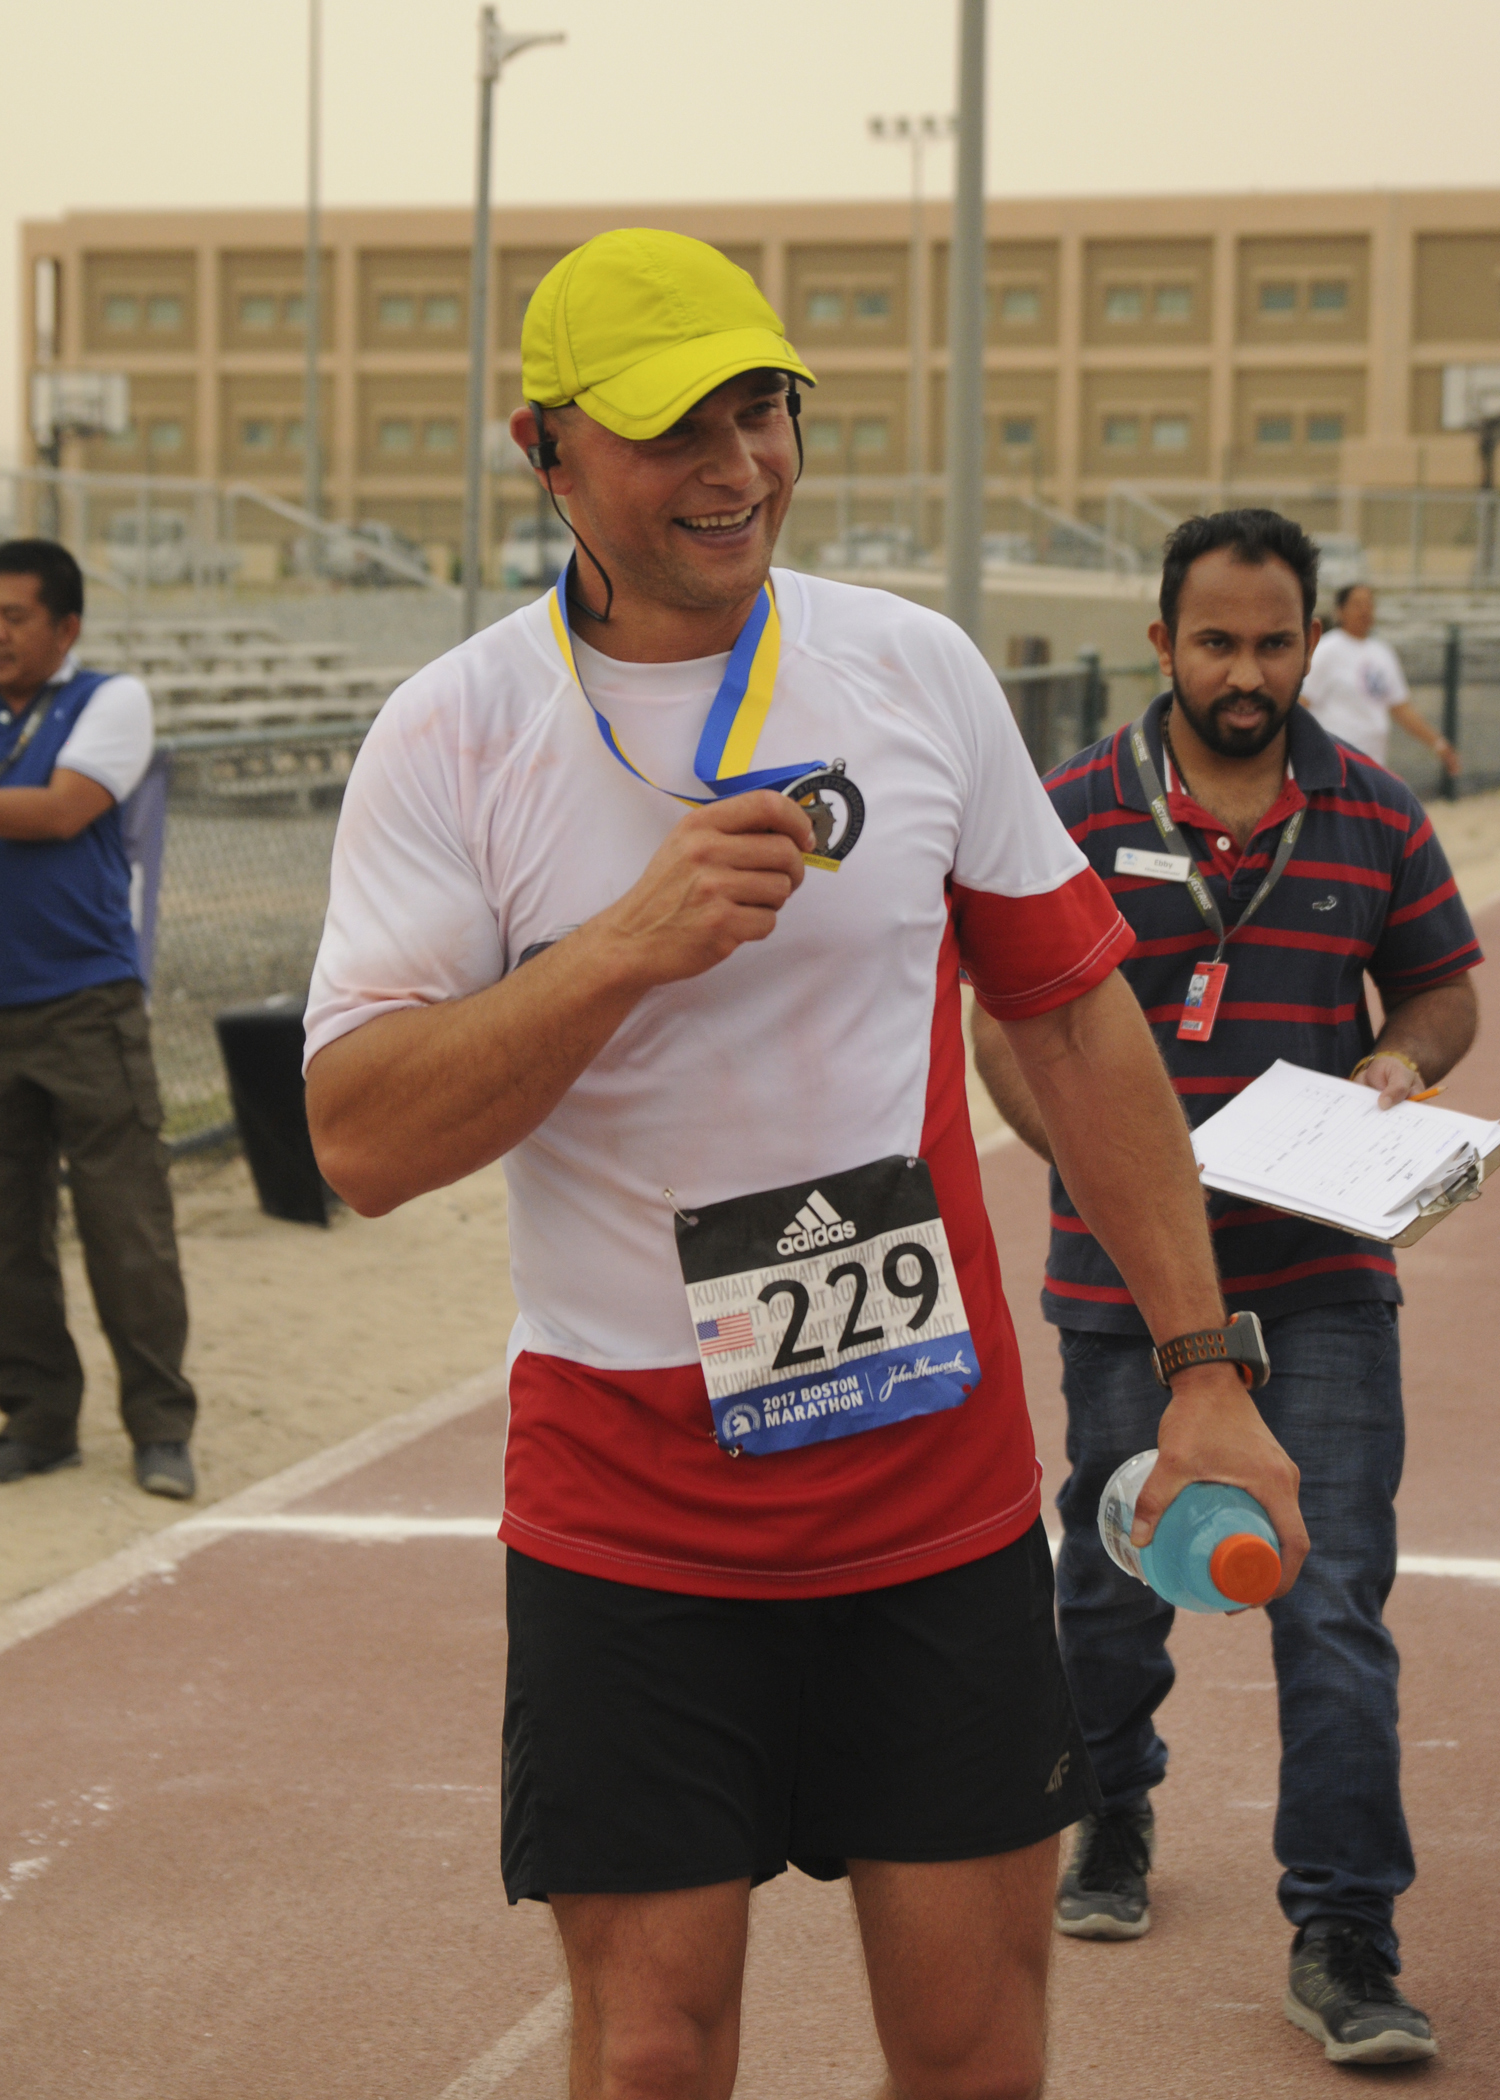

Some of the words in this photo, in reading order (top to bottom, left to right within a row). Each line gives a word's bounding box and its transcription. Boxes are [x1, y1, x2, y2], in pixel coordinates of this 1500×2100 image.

[1151, 799, 1175, 833] VECTRUS
[1154, 859, 1173, 869] Ebby
[1187, 877, 1212, 910] VECTRUS
[776, 1220, 857, 1256] adidas
[692, 1273, 755, 1307] KUWAIT
[757, 1242, 939, 1370] 229
[712, 1364, 774, 1395] KUWAIT
[762, 1390, 796, 1411] 2017
[801, 1375, 859, 1402] BOSTON
[879, 1364, 912, 1402] John
[764, 1391, 864, 1428] MARATHON
